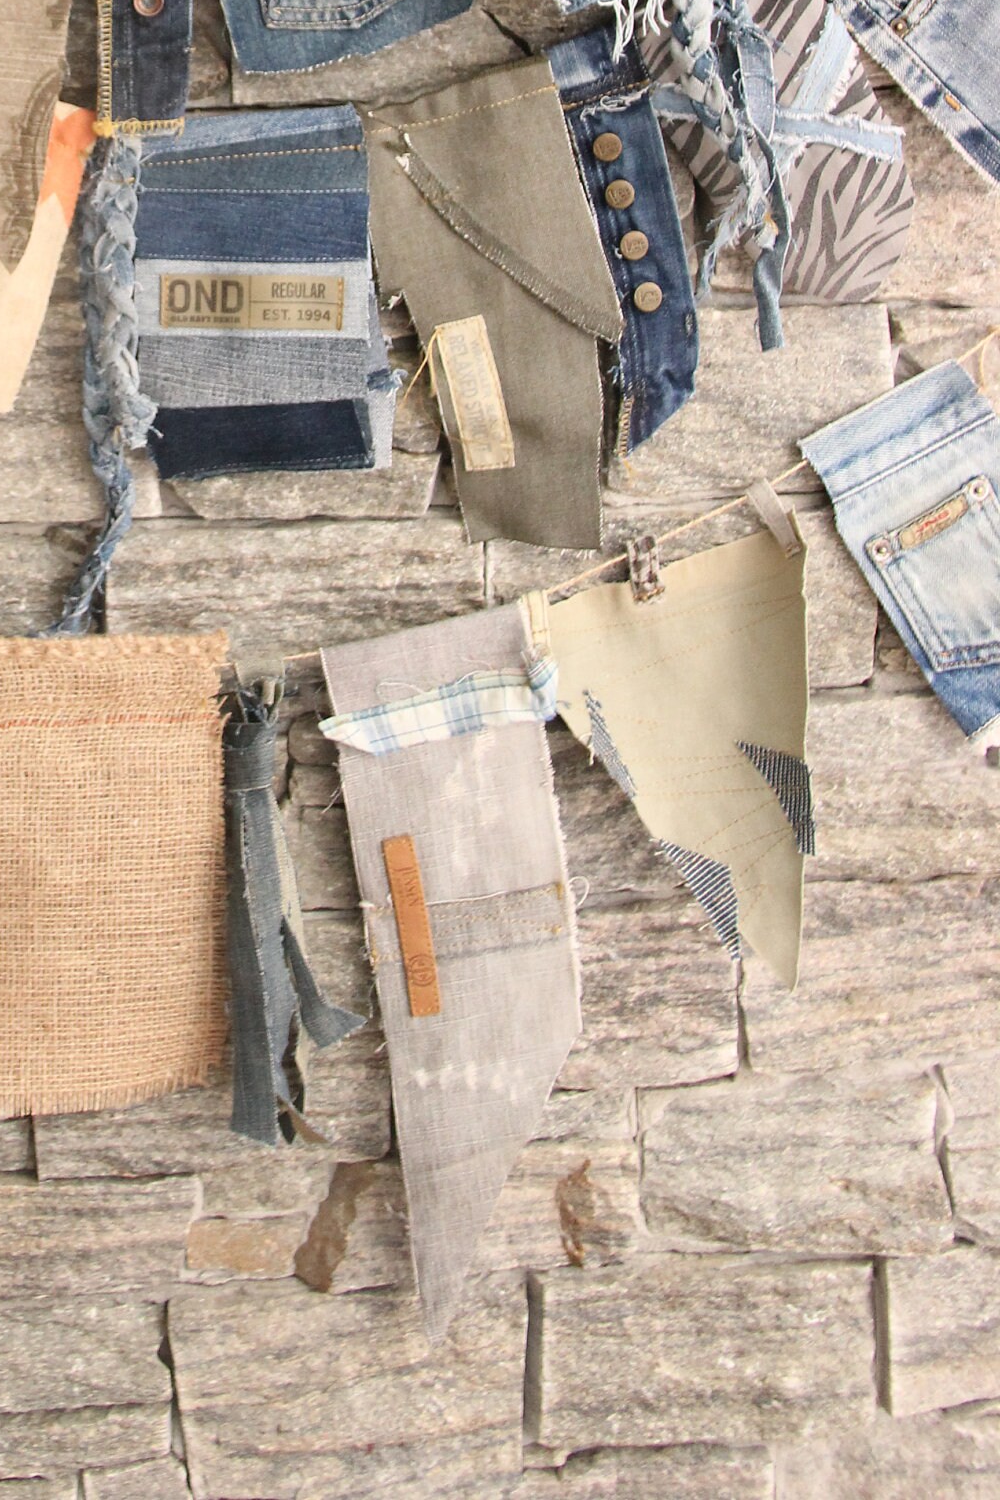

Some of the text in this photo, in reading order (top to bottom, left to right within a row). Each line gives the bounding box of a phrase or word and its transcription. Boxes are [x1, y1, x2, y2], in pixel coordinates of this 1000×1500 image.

[168, 279, 244, 314] OND
[271, 282, 326, 299] REGULAR
[263, 308, 331, 322] EST. 1994
